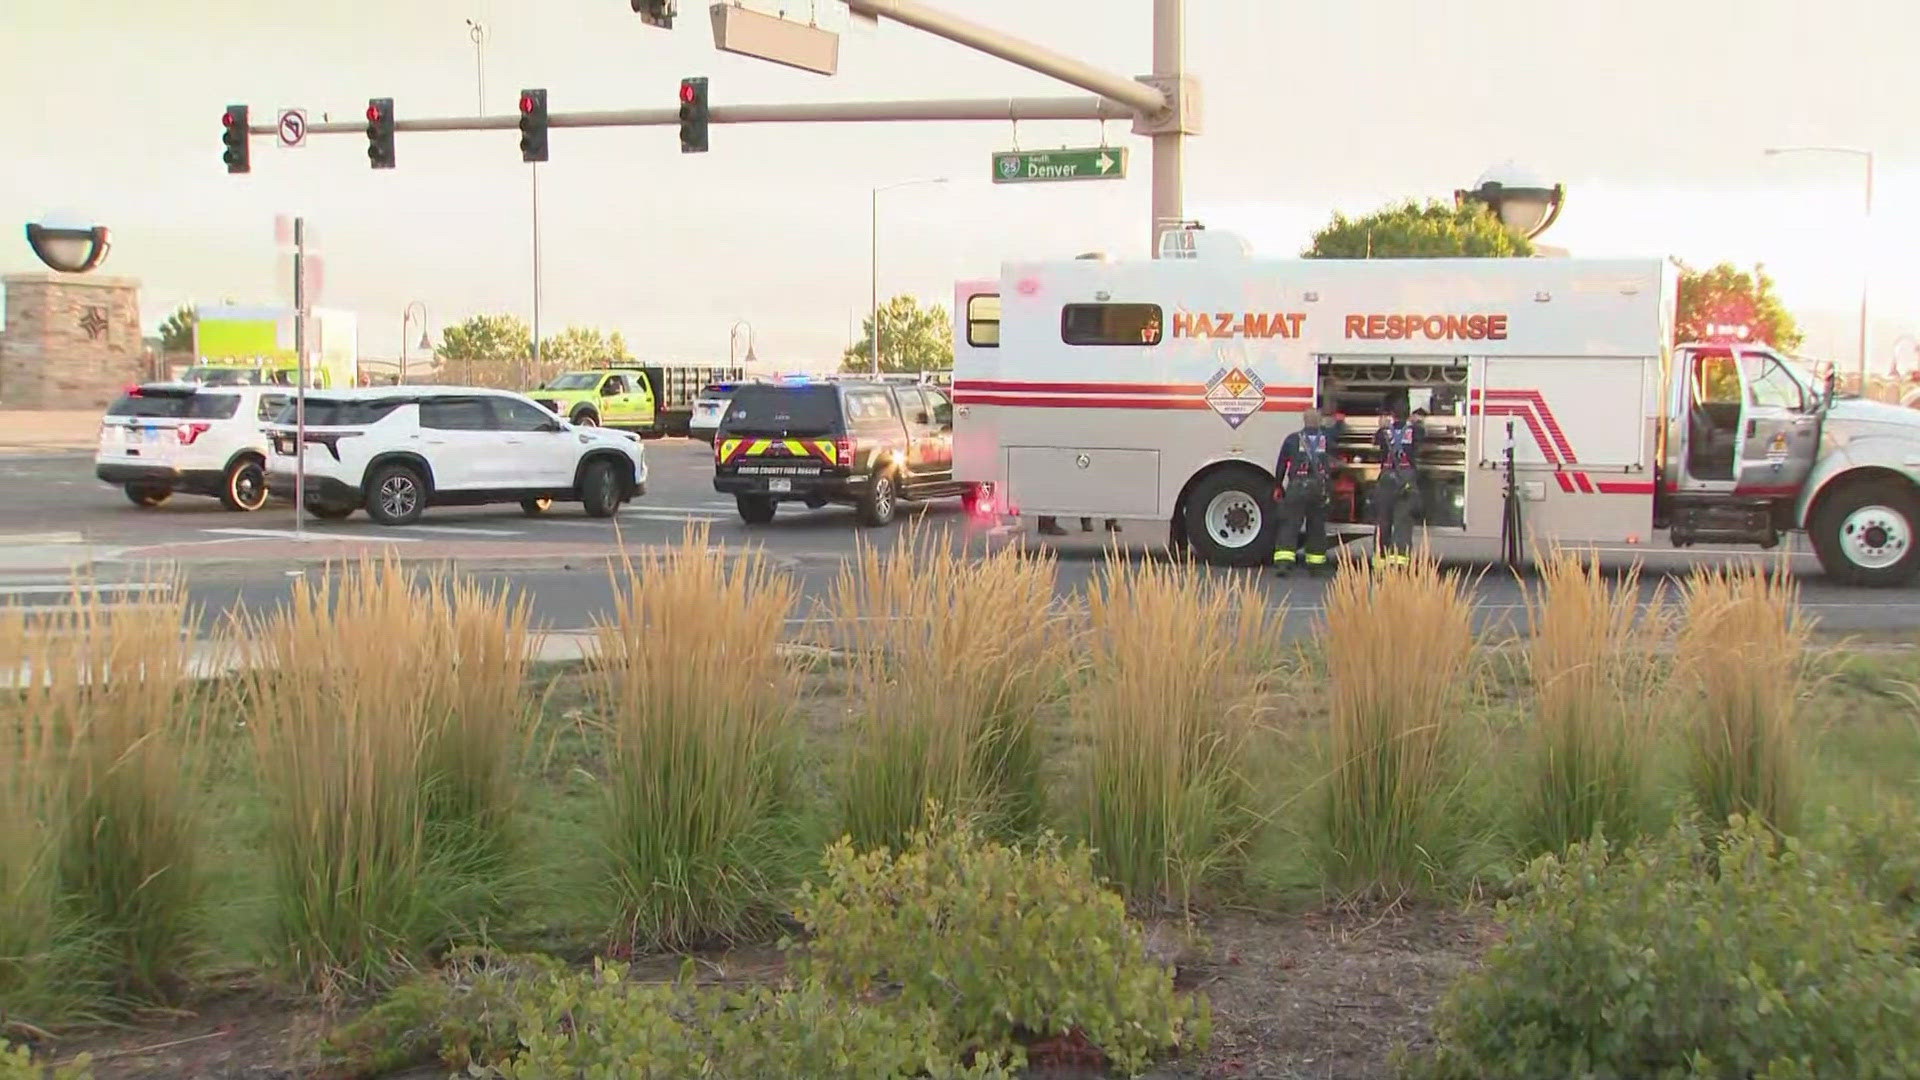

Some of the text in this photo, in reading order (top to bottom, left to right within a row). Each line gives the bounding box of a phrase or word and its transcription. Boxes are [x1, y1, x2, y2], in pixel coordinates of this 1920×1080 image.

[1003, 162, 1017, 173] 25
[1028, 163, 1077, 177] Denver
[1173, 313, 1507, 340] HAZ-MAT RESPONSE
[759, 466, 783, 475] COUNTY
